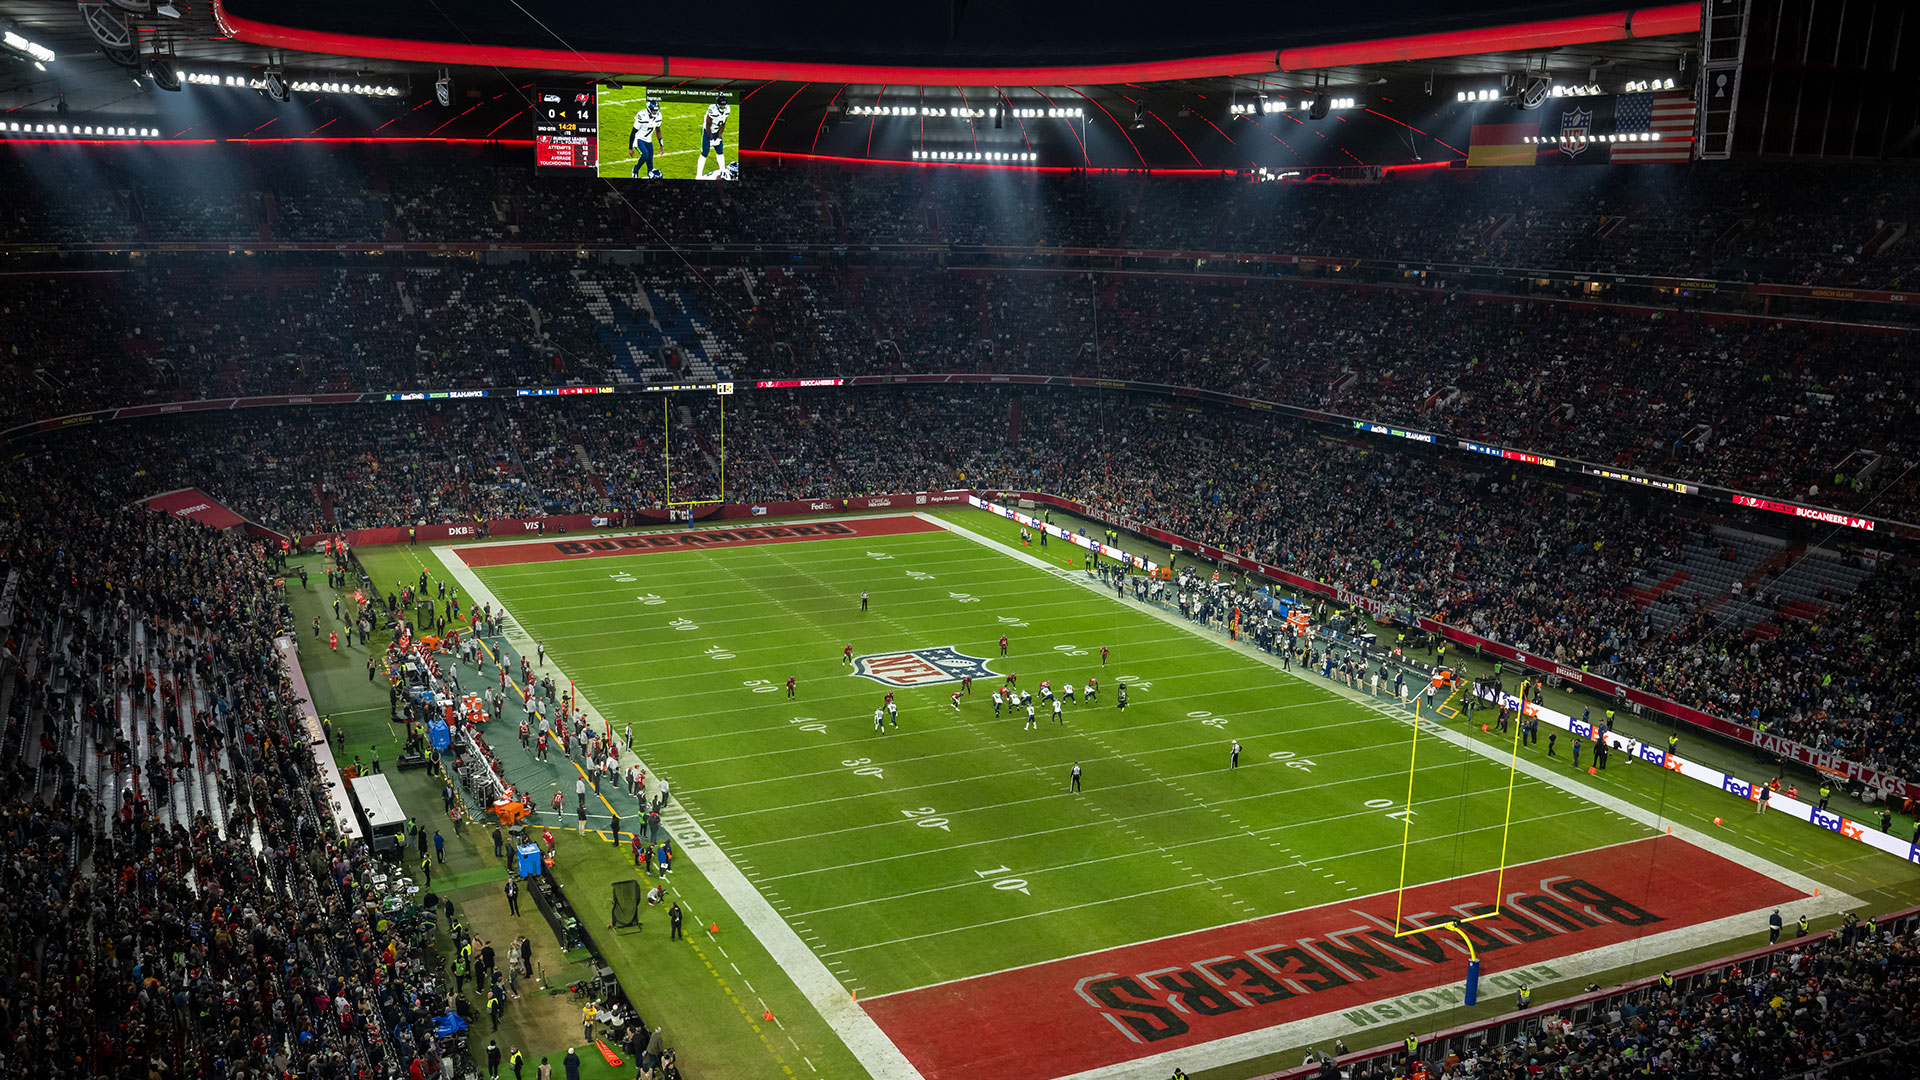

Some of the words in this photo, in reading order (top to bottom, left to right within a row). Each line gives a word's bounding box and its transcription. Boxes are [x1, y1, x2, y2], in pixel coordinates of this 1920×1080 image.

[548, 109, 555, 118] 0
[577, 110, 589, 119] 14
[1563, 129, 1585, 150] NFL
[1405, 432, 1431, 443] SEAHAWKS
[1085, 506, 1104, 521] RAISE
[1105, 512, 1119, 526] THE
[1119, 517, 1141, 533] FLAGS
[1796, 507, 1848, 525] BUCCANEERS
[448, 526, 468, 535] DKB
[556, 522, 857, 556] BUCCANEERS
[1337, 589, 1365, 610] RAISE
[669, 619, 698, 630] 30
[704, 648, 736, 660] 40
[1053, 644, 1088, 656] 50
[866, 654, 945, 684] NFL
[744, 680, 778, 692] 50
[789, 717, 827, 731] 40
[1186, 711, 1228, 728] 30
[841, 757, 883, 776] 30
[1268, 751, 1317, 770] 20
[1640, 743, 1683, 774] FedEx
[1752, 731, 1802, 760] RAISE
[1806, 748, 1842, 770] THE
[1847, 762, 1907, 796] FLAGS
[901, 806, 949, 828] 20
[1364, 798, 1417, 822] 10
[1810, 806, 1864, 842] FedEx
[974, 865, 1028, 891] 10
[1073, 876, 1667, 1044] BUCCANEERS
[1489, 965, 1562, 990] END
